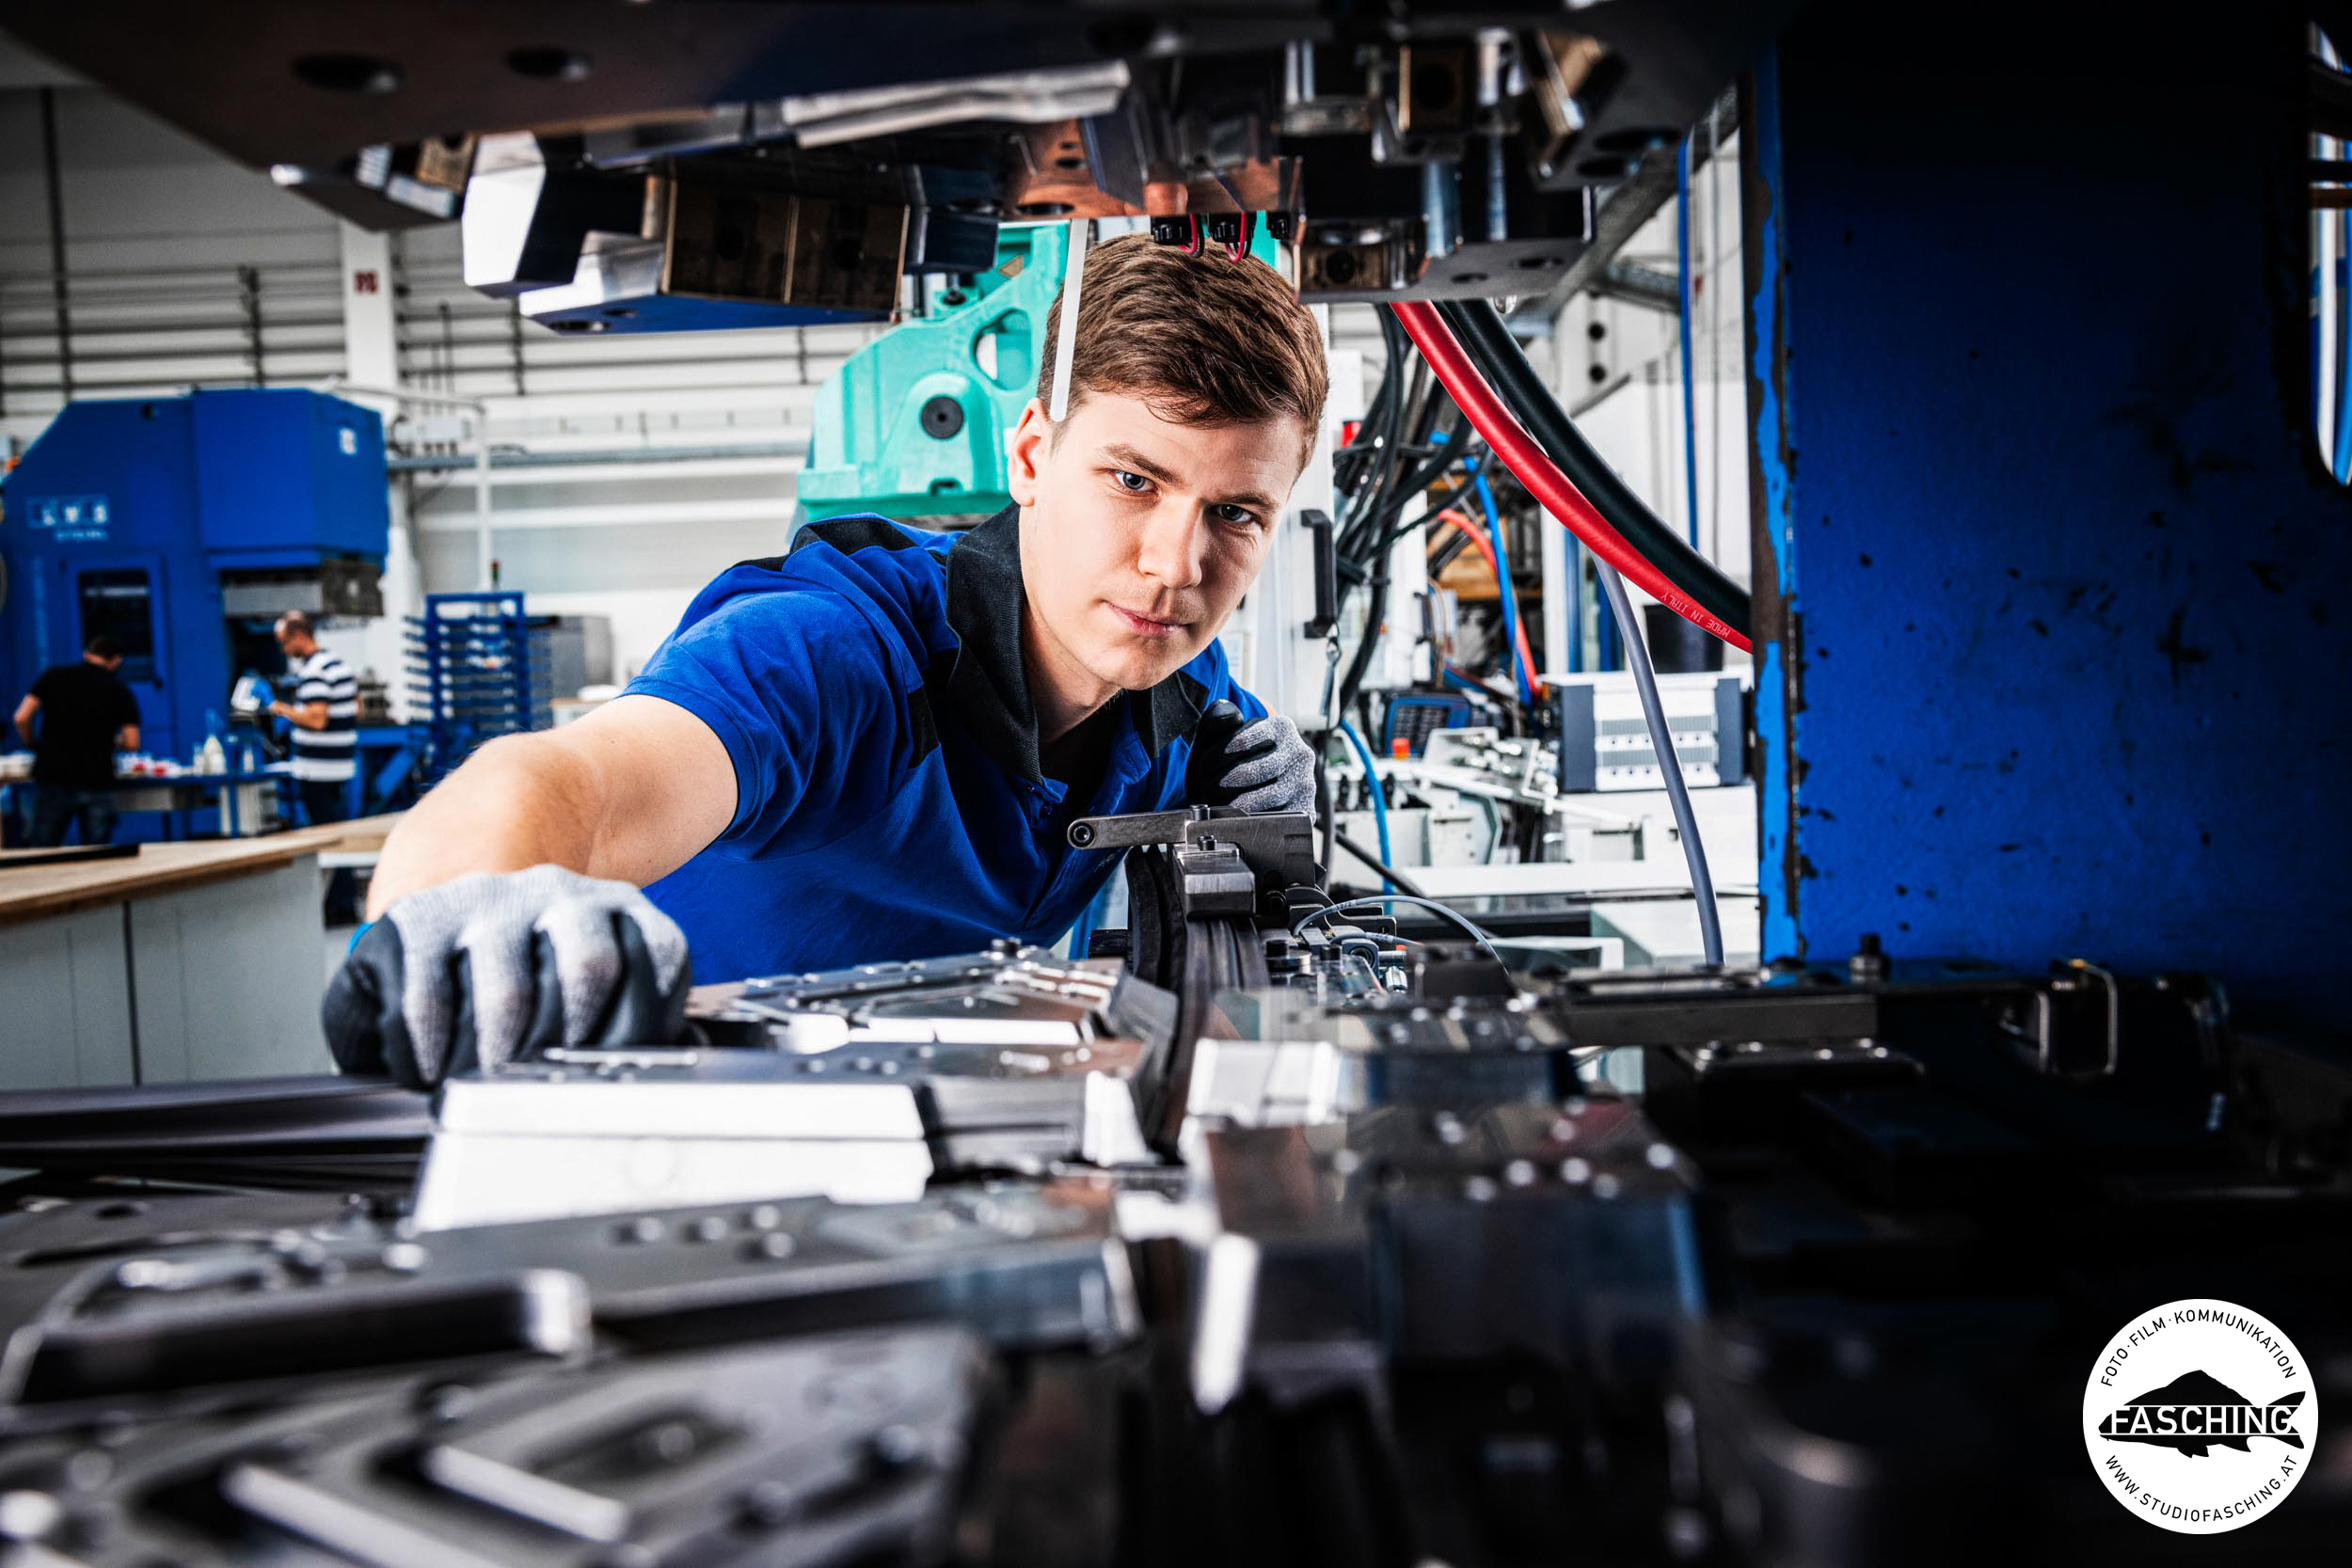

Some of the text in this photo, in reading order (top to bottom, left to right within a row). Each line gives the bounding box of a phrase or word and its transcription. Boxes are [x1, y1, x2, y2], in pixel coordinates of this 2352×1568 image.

[1661, 592, 1731, 638] MADE IN ITALY
